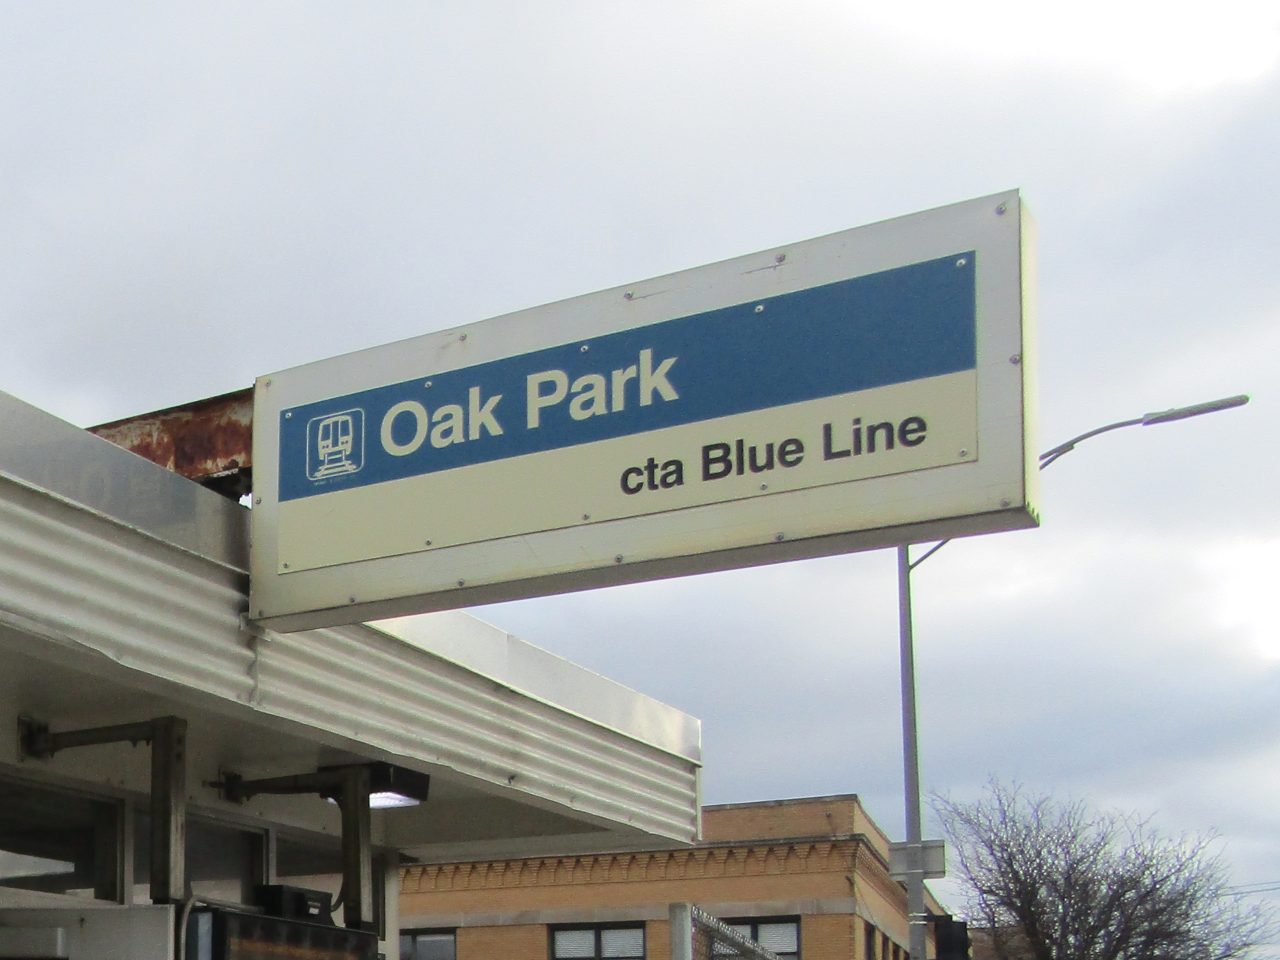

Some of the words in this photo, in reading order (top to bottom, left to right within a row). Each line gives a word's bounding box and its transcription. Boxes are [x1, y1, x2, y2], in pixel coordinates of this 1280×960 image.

[380, 386, 504, 456] Oak
[526, 347, 680, 430] Park
[621, 457, 684, 495] cta
[702, 438, 804, 481] Blue
[823, 415, 927, 461] Line
